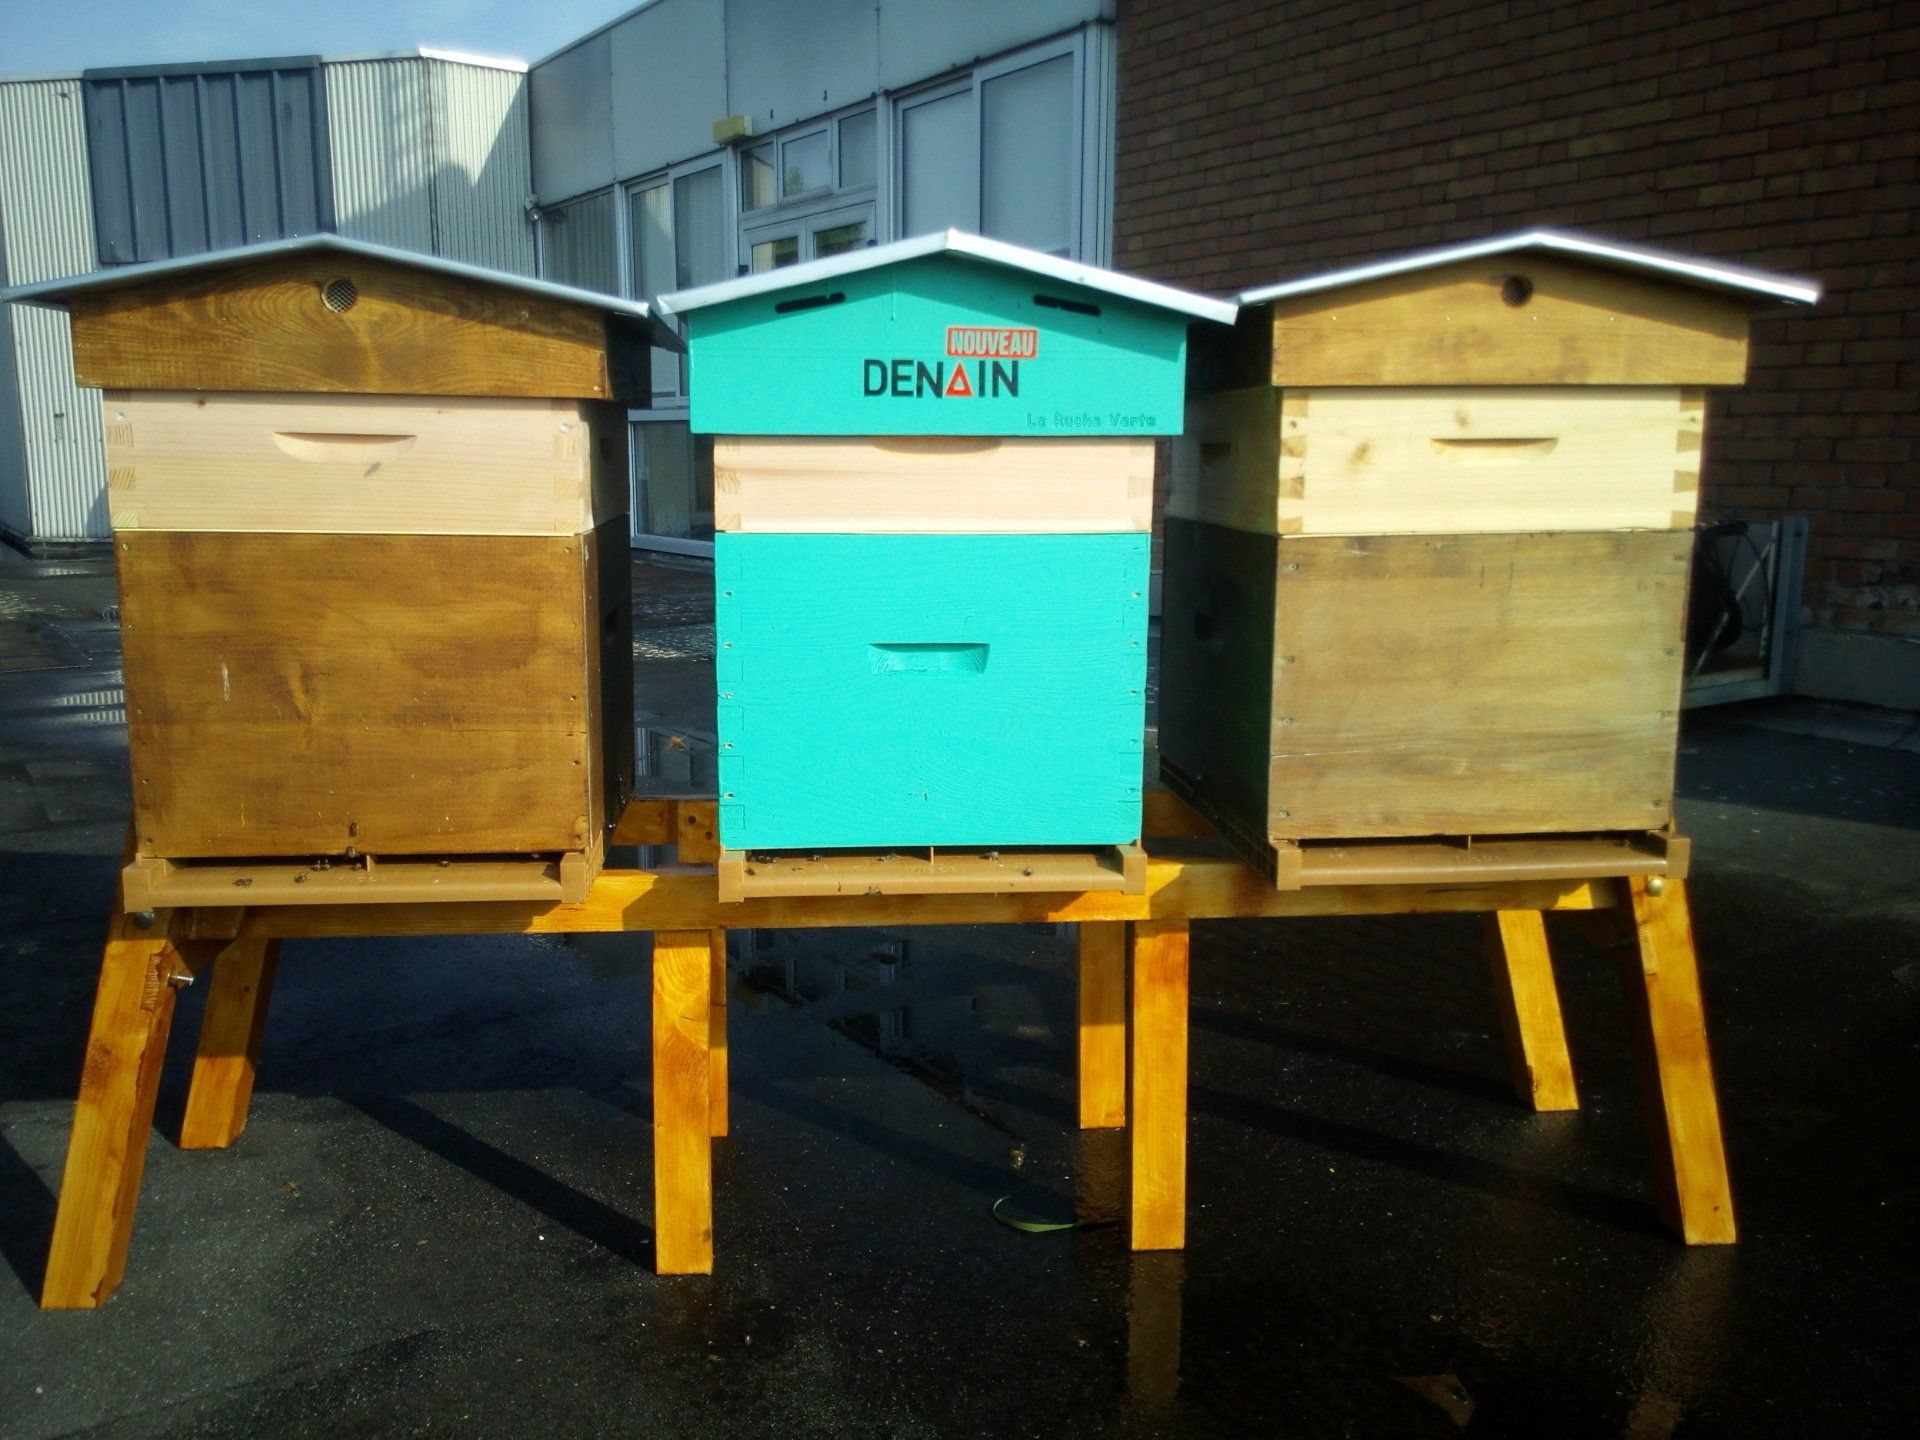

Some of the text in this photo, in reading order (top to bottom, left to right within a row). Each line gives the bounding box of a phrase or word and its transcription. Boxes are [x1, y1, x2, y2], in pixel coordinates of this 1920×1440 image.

[950, 329, 1035, 356] NOUVEAU
[863, 359, 1019, 398] DENAIN
[1026, 412, 1046, 428] La
